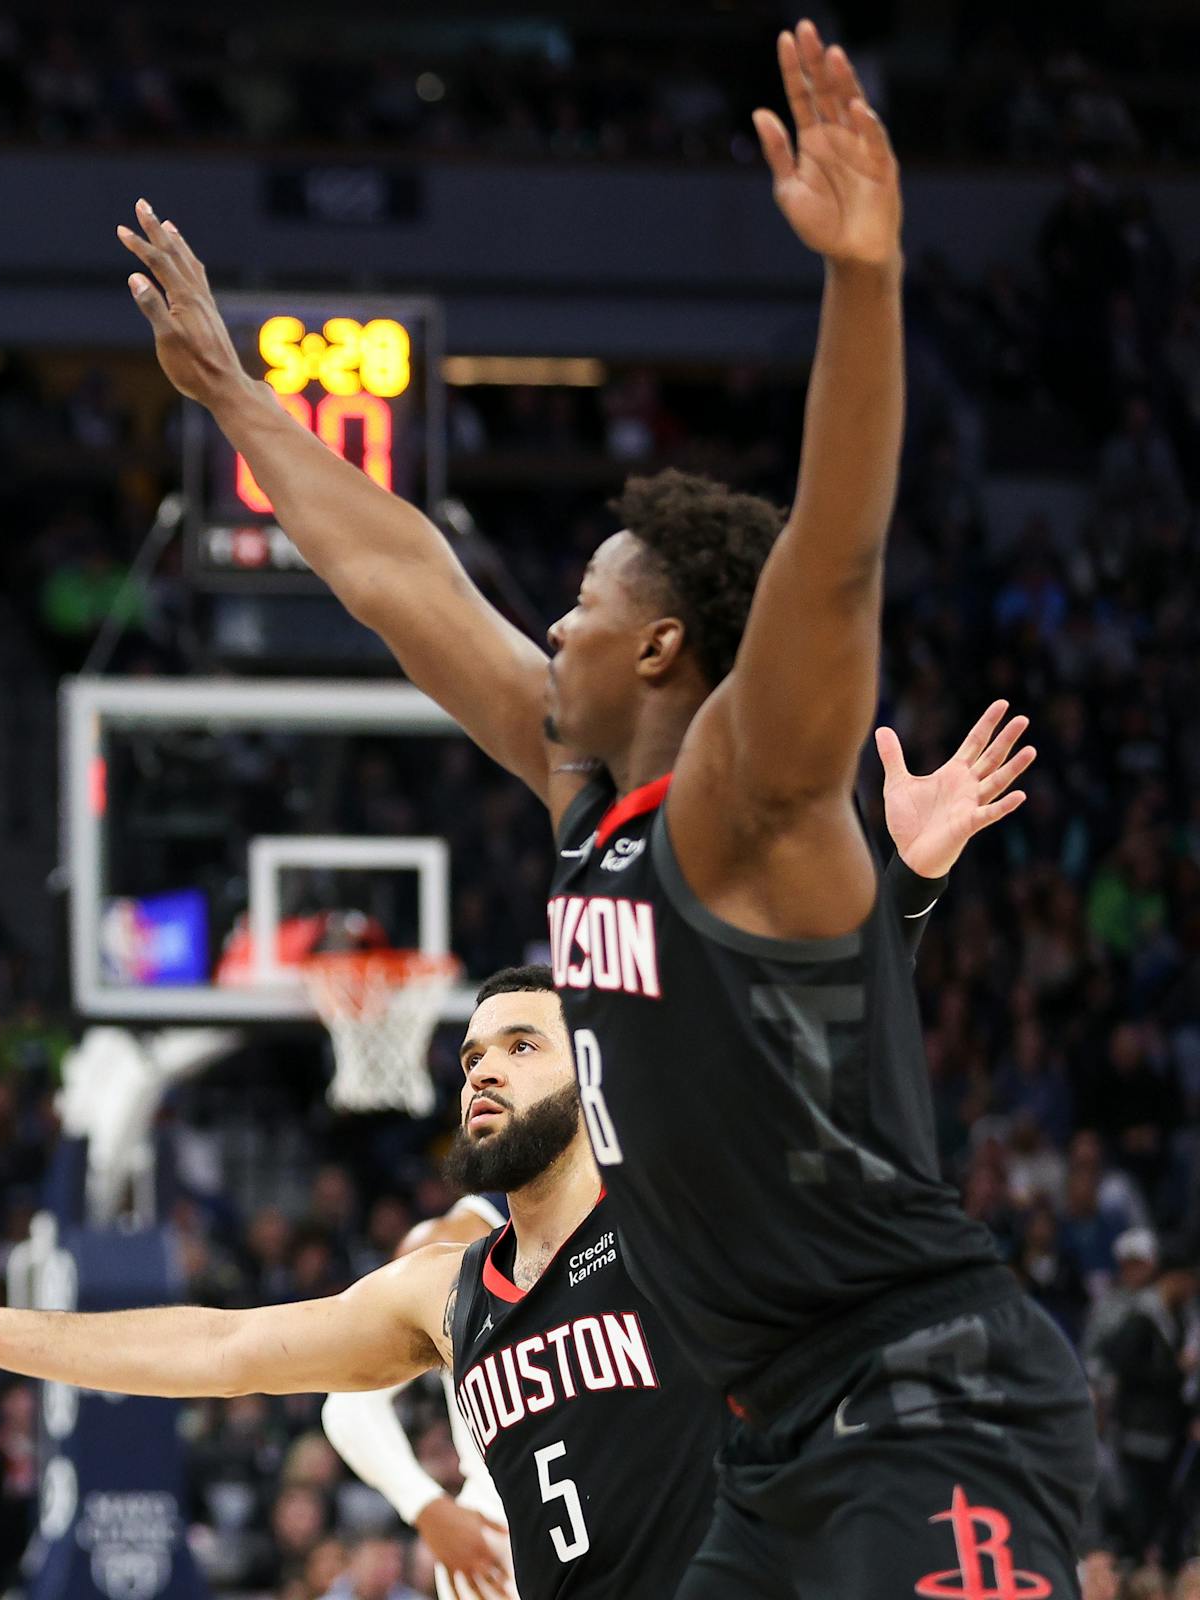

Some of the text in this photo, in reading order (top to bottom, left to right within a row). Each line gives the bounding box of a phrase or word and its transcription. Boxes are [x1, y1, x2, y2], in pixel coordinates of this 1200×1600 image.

[258, 315, 410, 398] 5:28
[573, 1028, 624, 1166] 8
[568, 1249, 617, 1287] karma
[569, 1231, 615, 1269] credit
[456, 1310, 660, 1460] HOUSTON
[533, 1439, 591, 1564] 5
